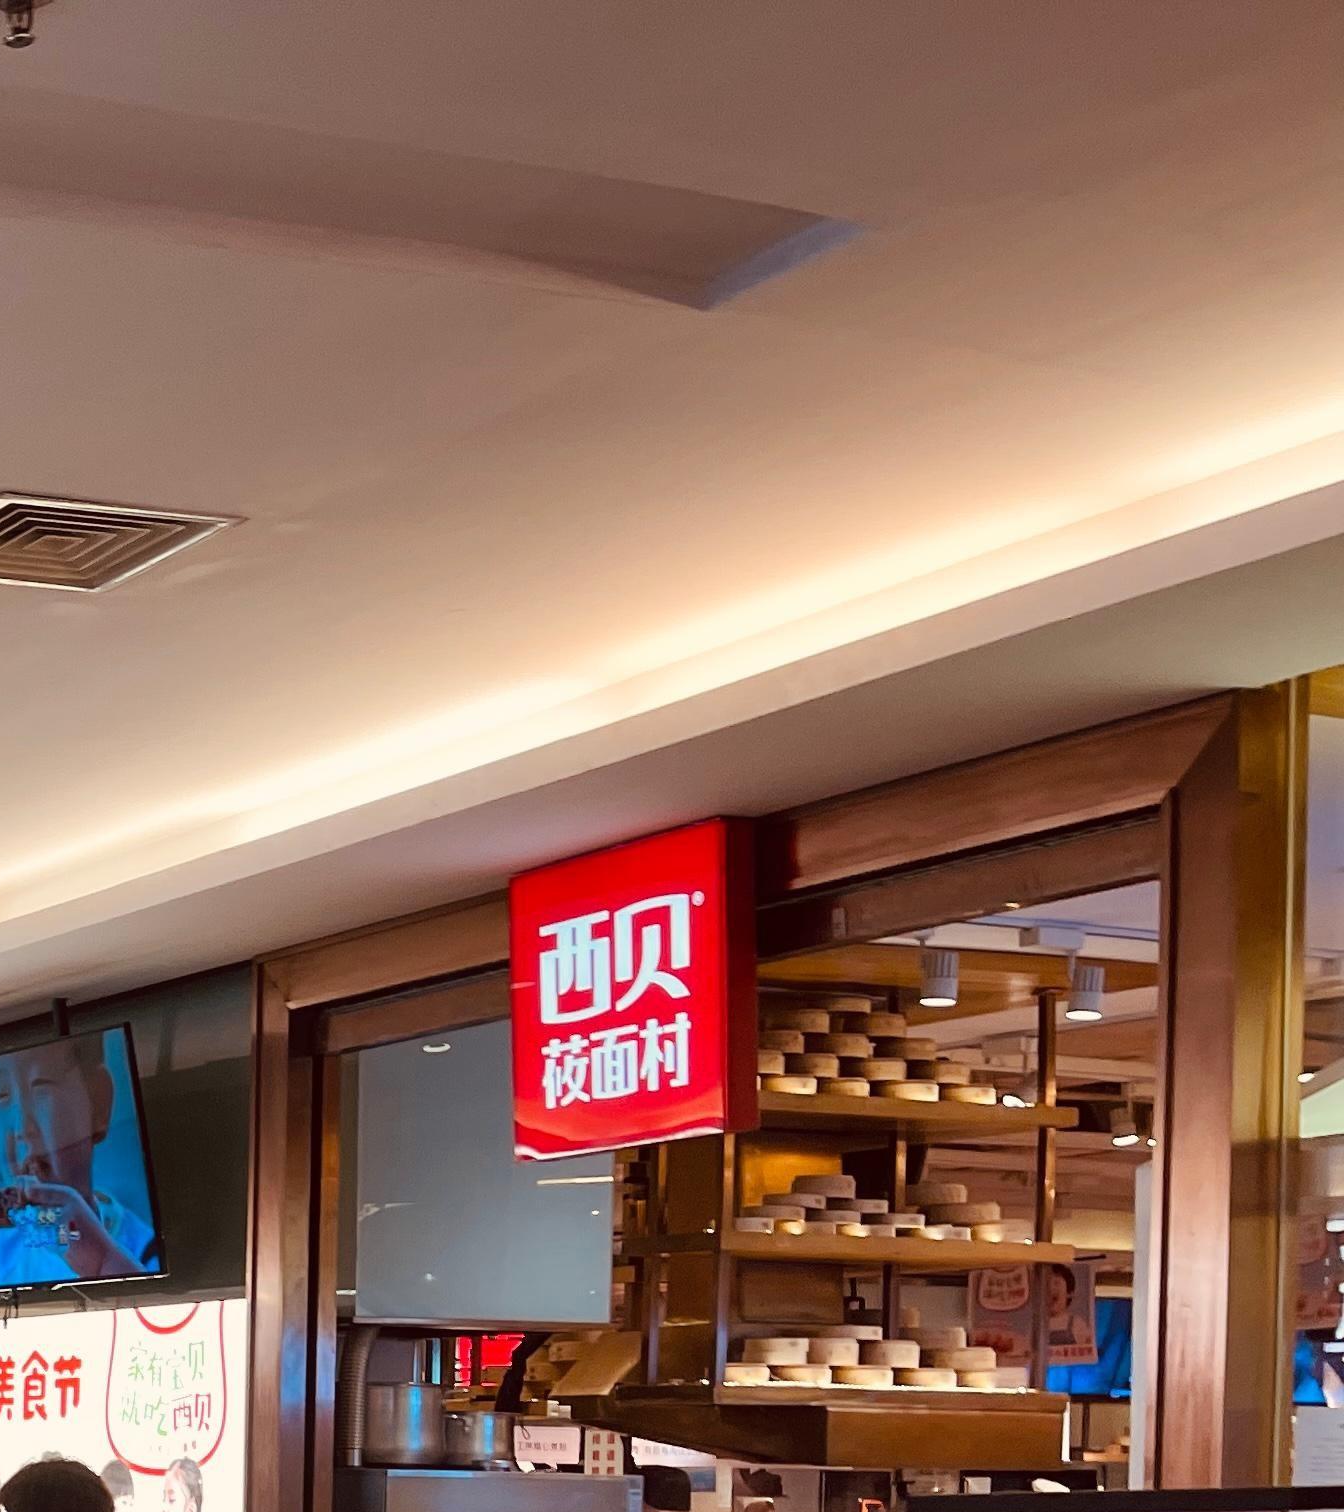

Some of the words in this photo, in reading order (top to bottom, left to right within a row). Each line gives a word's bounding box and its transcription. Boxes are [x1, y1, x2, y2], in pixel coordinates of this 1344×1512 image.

[538, 892, 692, 1025] 西贝
[540, 1011, 692, 1110] 莜面村
